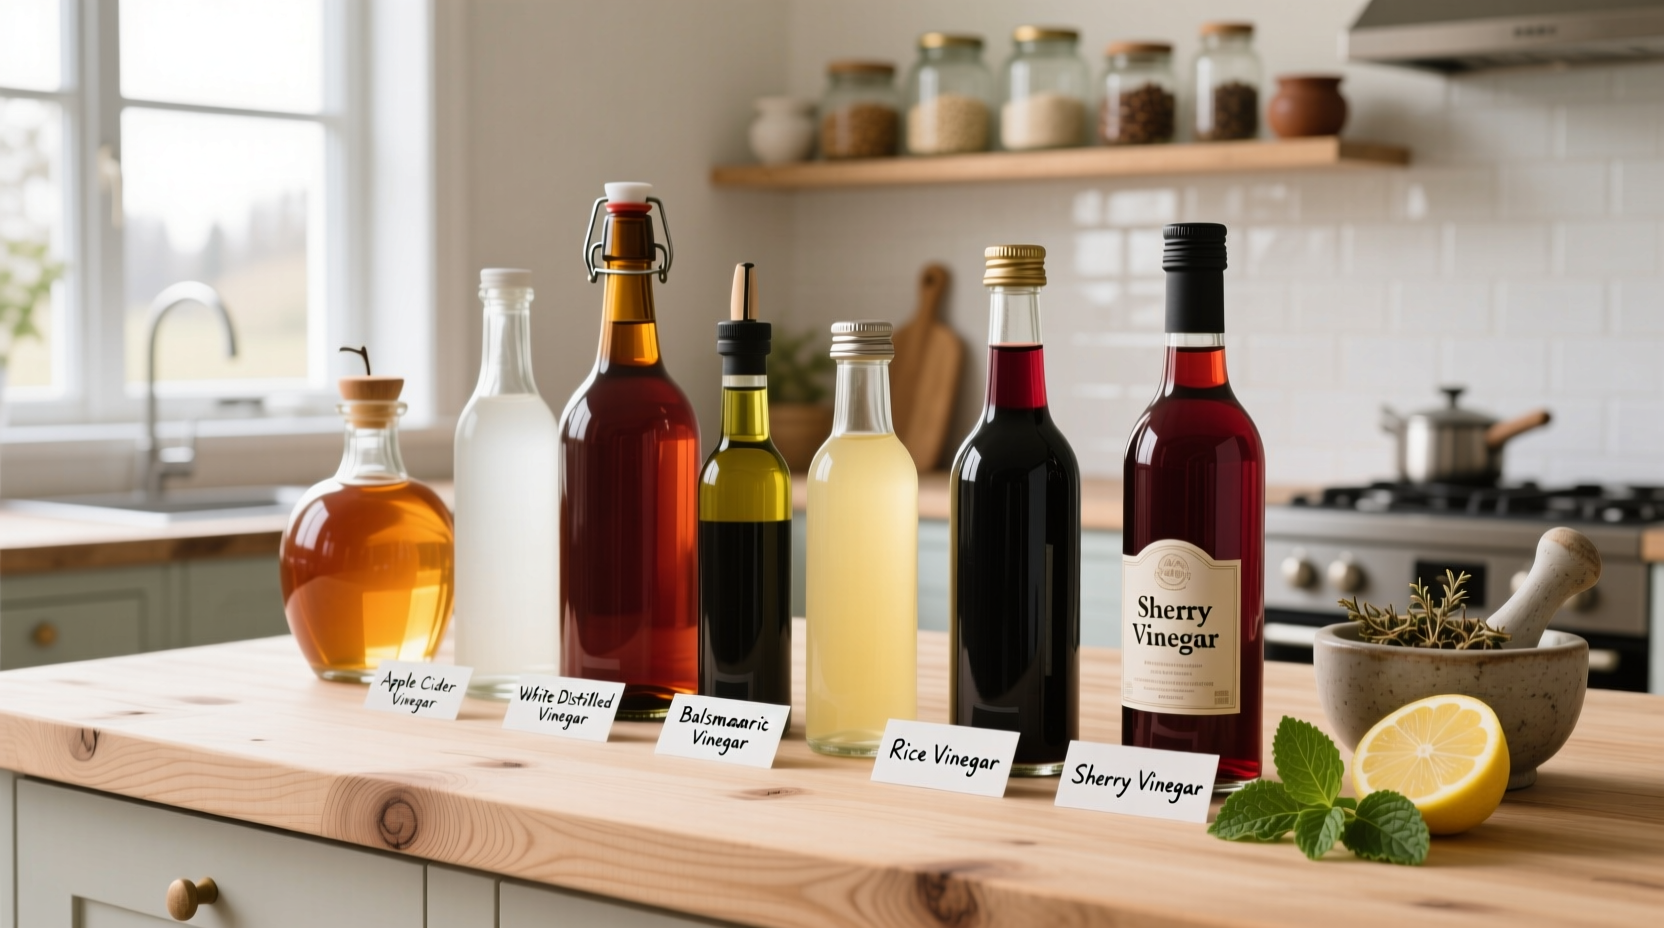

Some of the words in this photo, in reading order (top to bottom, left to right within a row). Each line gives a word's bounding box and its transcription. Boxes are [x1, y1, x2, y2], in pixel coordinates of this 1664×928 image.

[1138, 595, 1213, 627] Sherry
[1132, 622, 1219, 656] Vinegar
[379, 671, 417, 696] Apple
[421, 676, 457, 693] Cider
[520, 685, 555, 704] White
[393, 692, 438, 715] Vinegar
[539, 707, 589, 731] Vinegar
[693, 729, 749, 756] Vinegar
[889, 738, 927, 762] Rice
[934, 743, 1000, 778] Vinegar
[1071, 763, 1132, 799] Sherry
[1138, 769, 1204, 804] Vinegar
